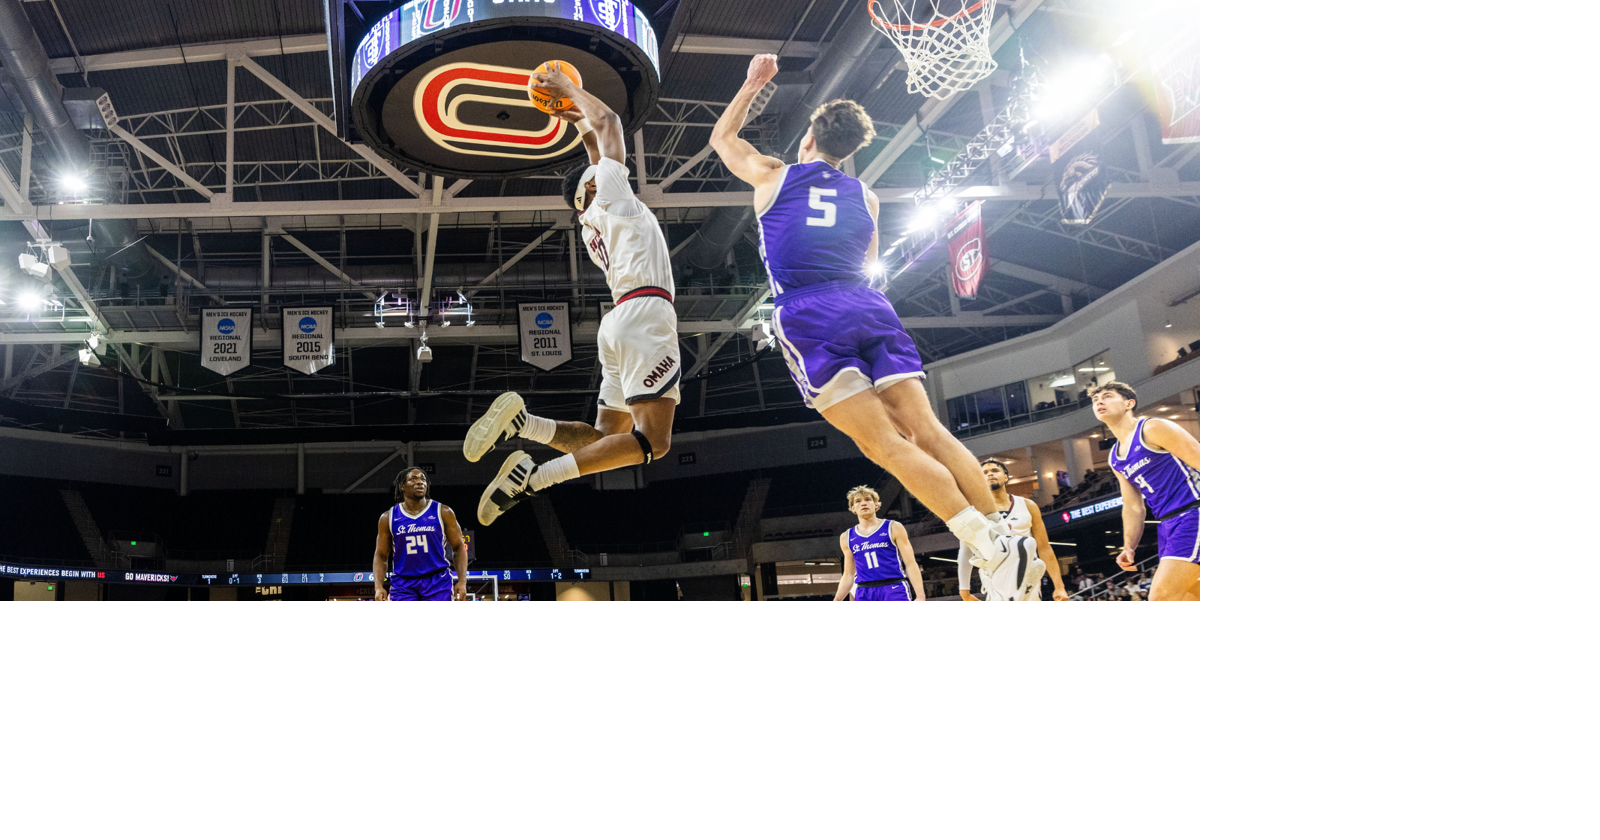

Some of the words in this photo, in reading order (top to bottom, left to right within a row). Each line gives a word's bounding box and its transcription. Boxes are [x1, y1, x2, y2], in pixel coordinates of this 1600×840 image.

[806, 186, 838, 228] 5
[214, 342, 238, 354] 2021
[296, 341, 321, 353] 2015
[534, 337, 558, 349] 2011
[643, 355, 676, 388] OMAHA
[810, 439, 824, 447] 224
[681, 455, 693, 463] 223
[1123, 457, 1151, 478] Thomas
[1070, 508, 1082, 520] THE
[1081, 504, 1095, 517] BEST
[396, 524, 406, 536] St.
[407, 523, 436, 534] Thomas
[405, 534, 429, 555] 24
[852, 543, 861, 554] St.
[860, 541, 890, 552] Thomas
[864, 551, 880, 570] 11
[7, 566, 19, 574] BEST
[20, 567, 60, 577] EXPERIENCES
[97, 571, 106, 579] US
[125, 572, 134, 581] GO
[135, 573, 170, 582] MAVERICKS!
